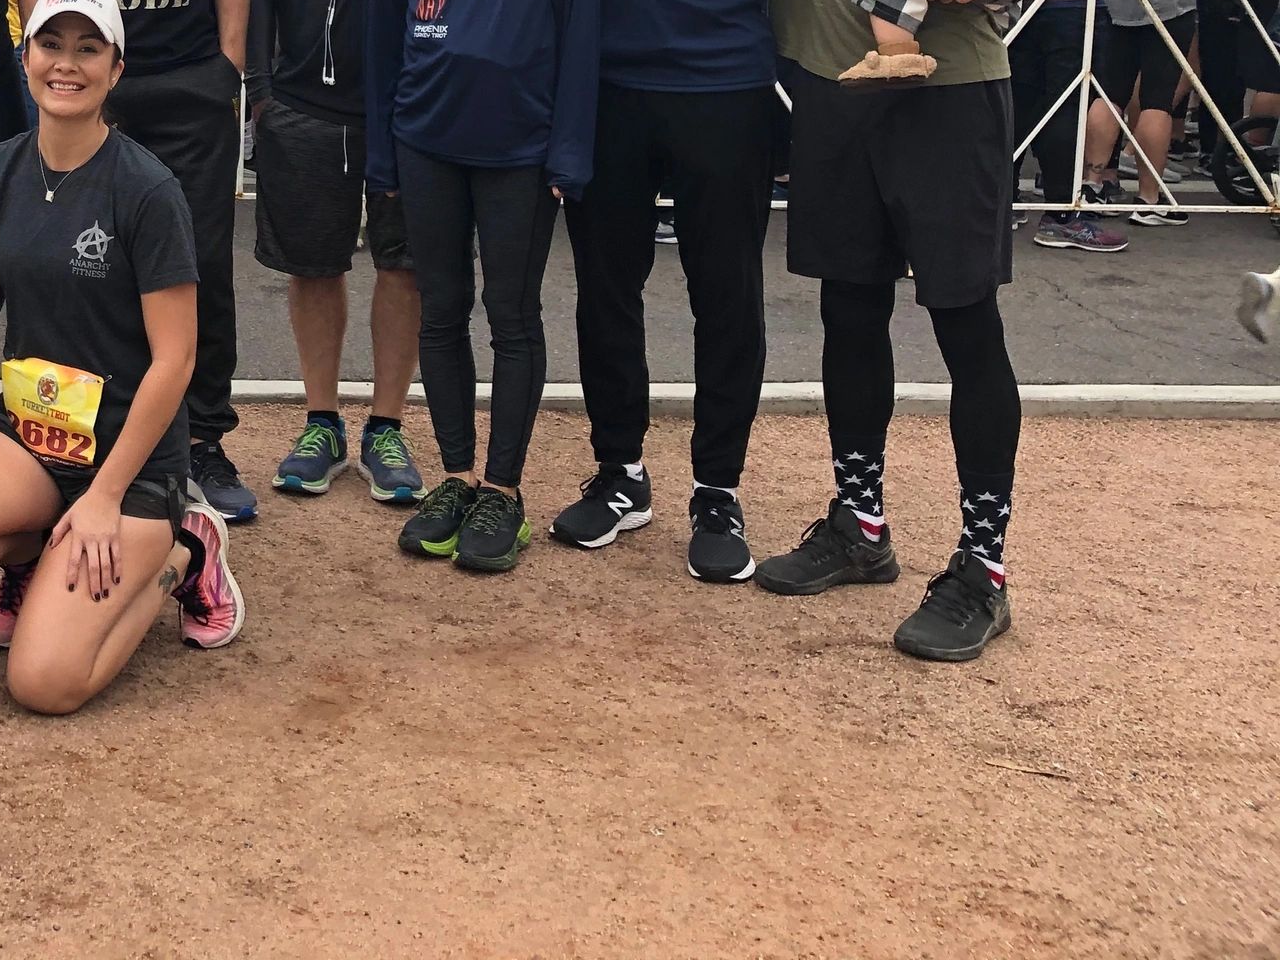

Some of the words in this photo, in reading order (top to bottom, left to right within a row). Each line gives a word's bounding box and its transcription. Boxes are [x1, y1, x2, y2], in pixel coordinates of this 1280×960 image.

[414, 25, 448, 33] PHOENIX
[69, 258, 111, 271] ANARCHY
[71, 267, 106, 279] FITNESS
